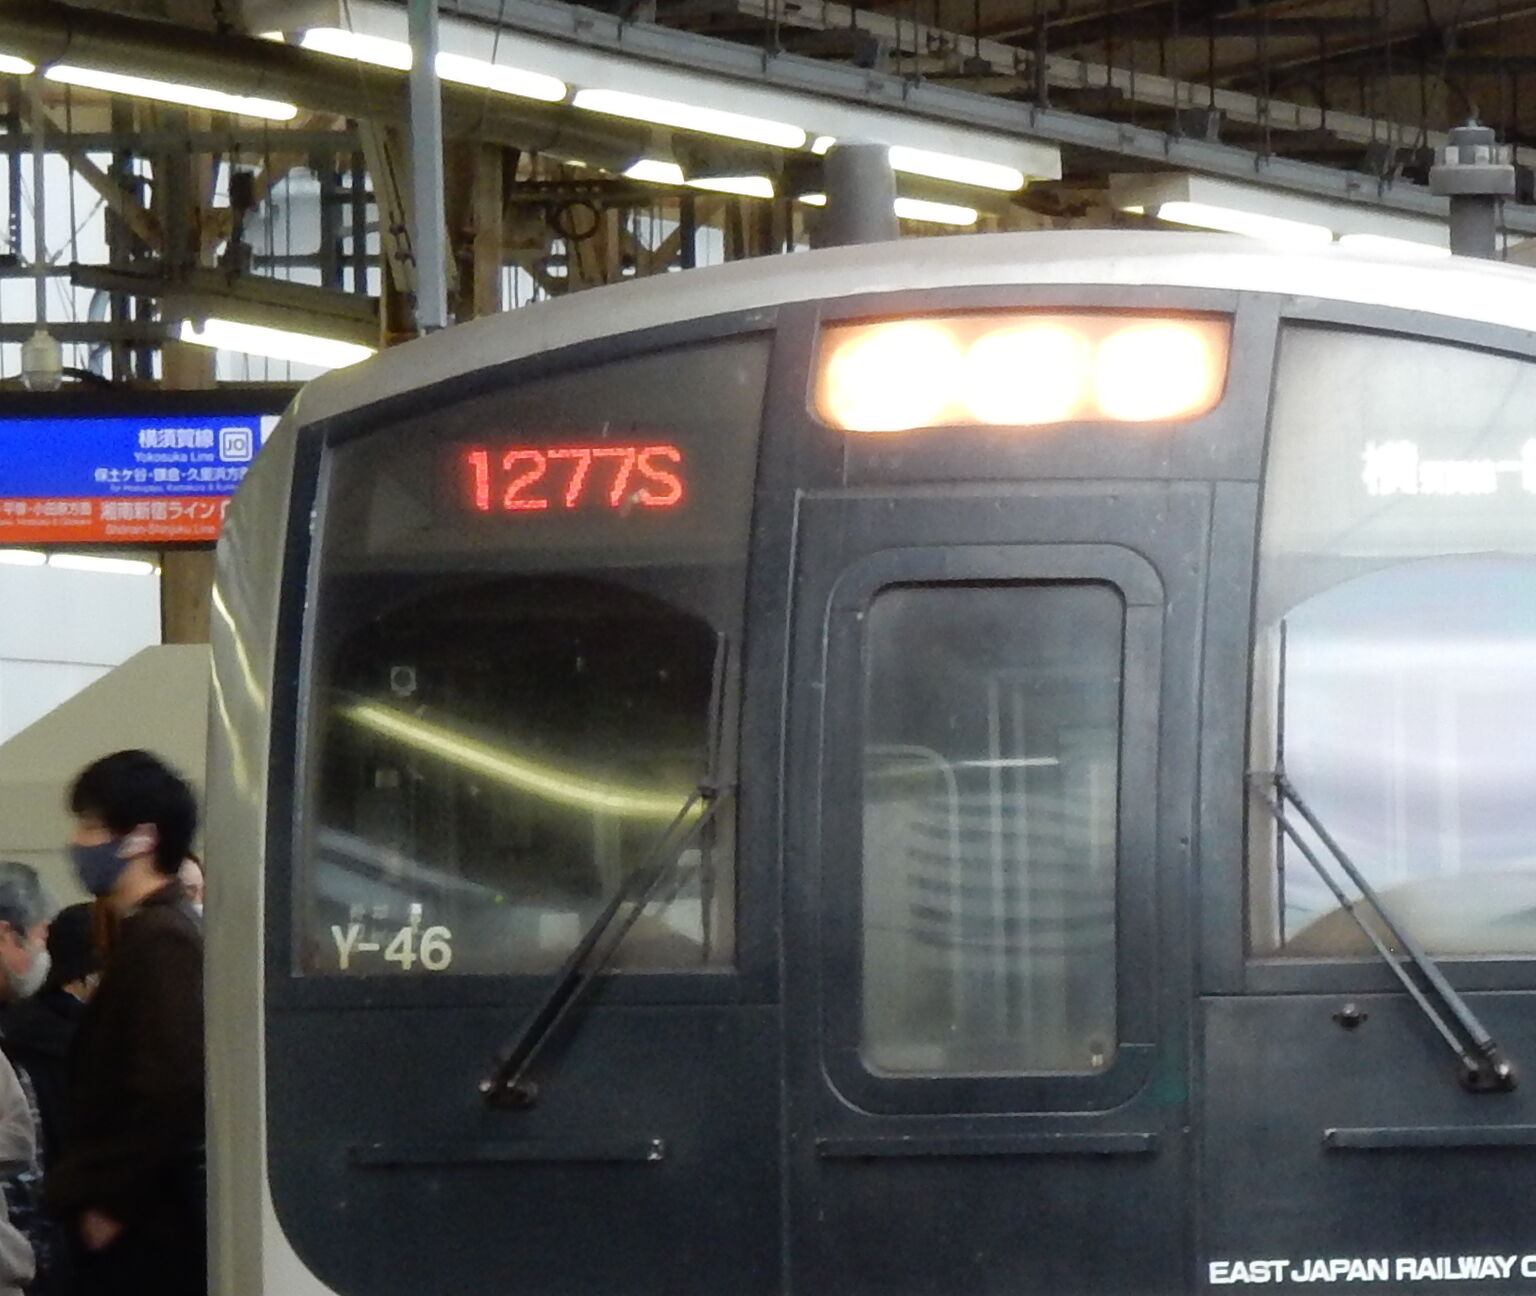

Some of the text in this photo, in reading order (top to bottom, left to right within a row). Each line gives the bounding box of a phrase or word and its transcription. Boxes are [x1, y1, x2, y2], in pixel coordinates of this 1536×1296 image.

[467, 445, 683, 511] 1277S
[330, 924, 453, 972] Y-46
[1208, 1259, 1290, 1285] EAST
[1291, 1256, 1389, 1283] JAPAN
[1395, 1254, 1517, 1282] RAILWAY
